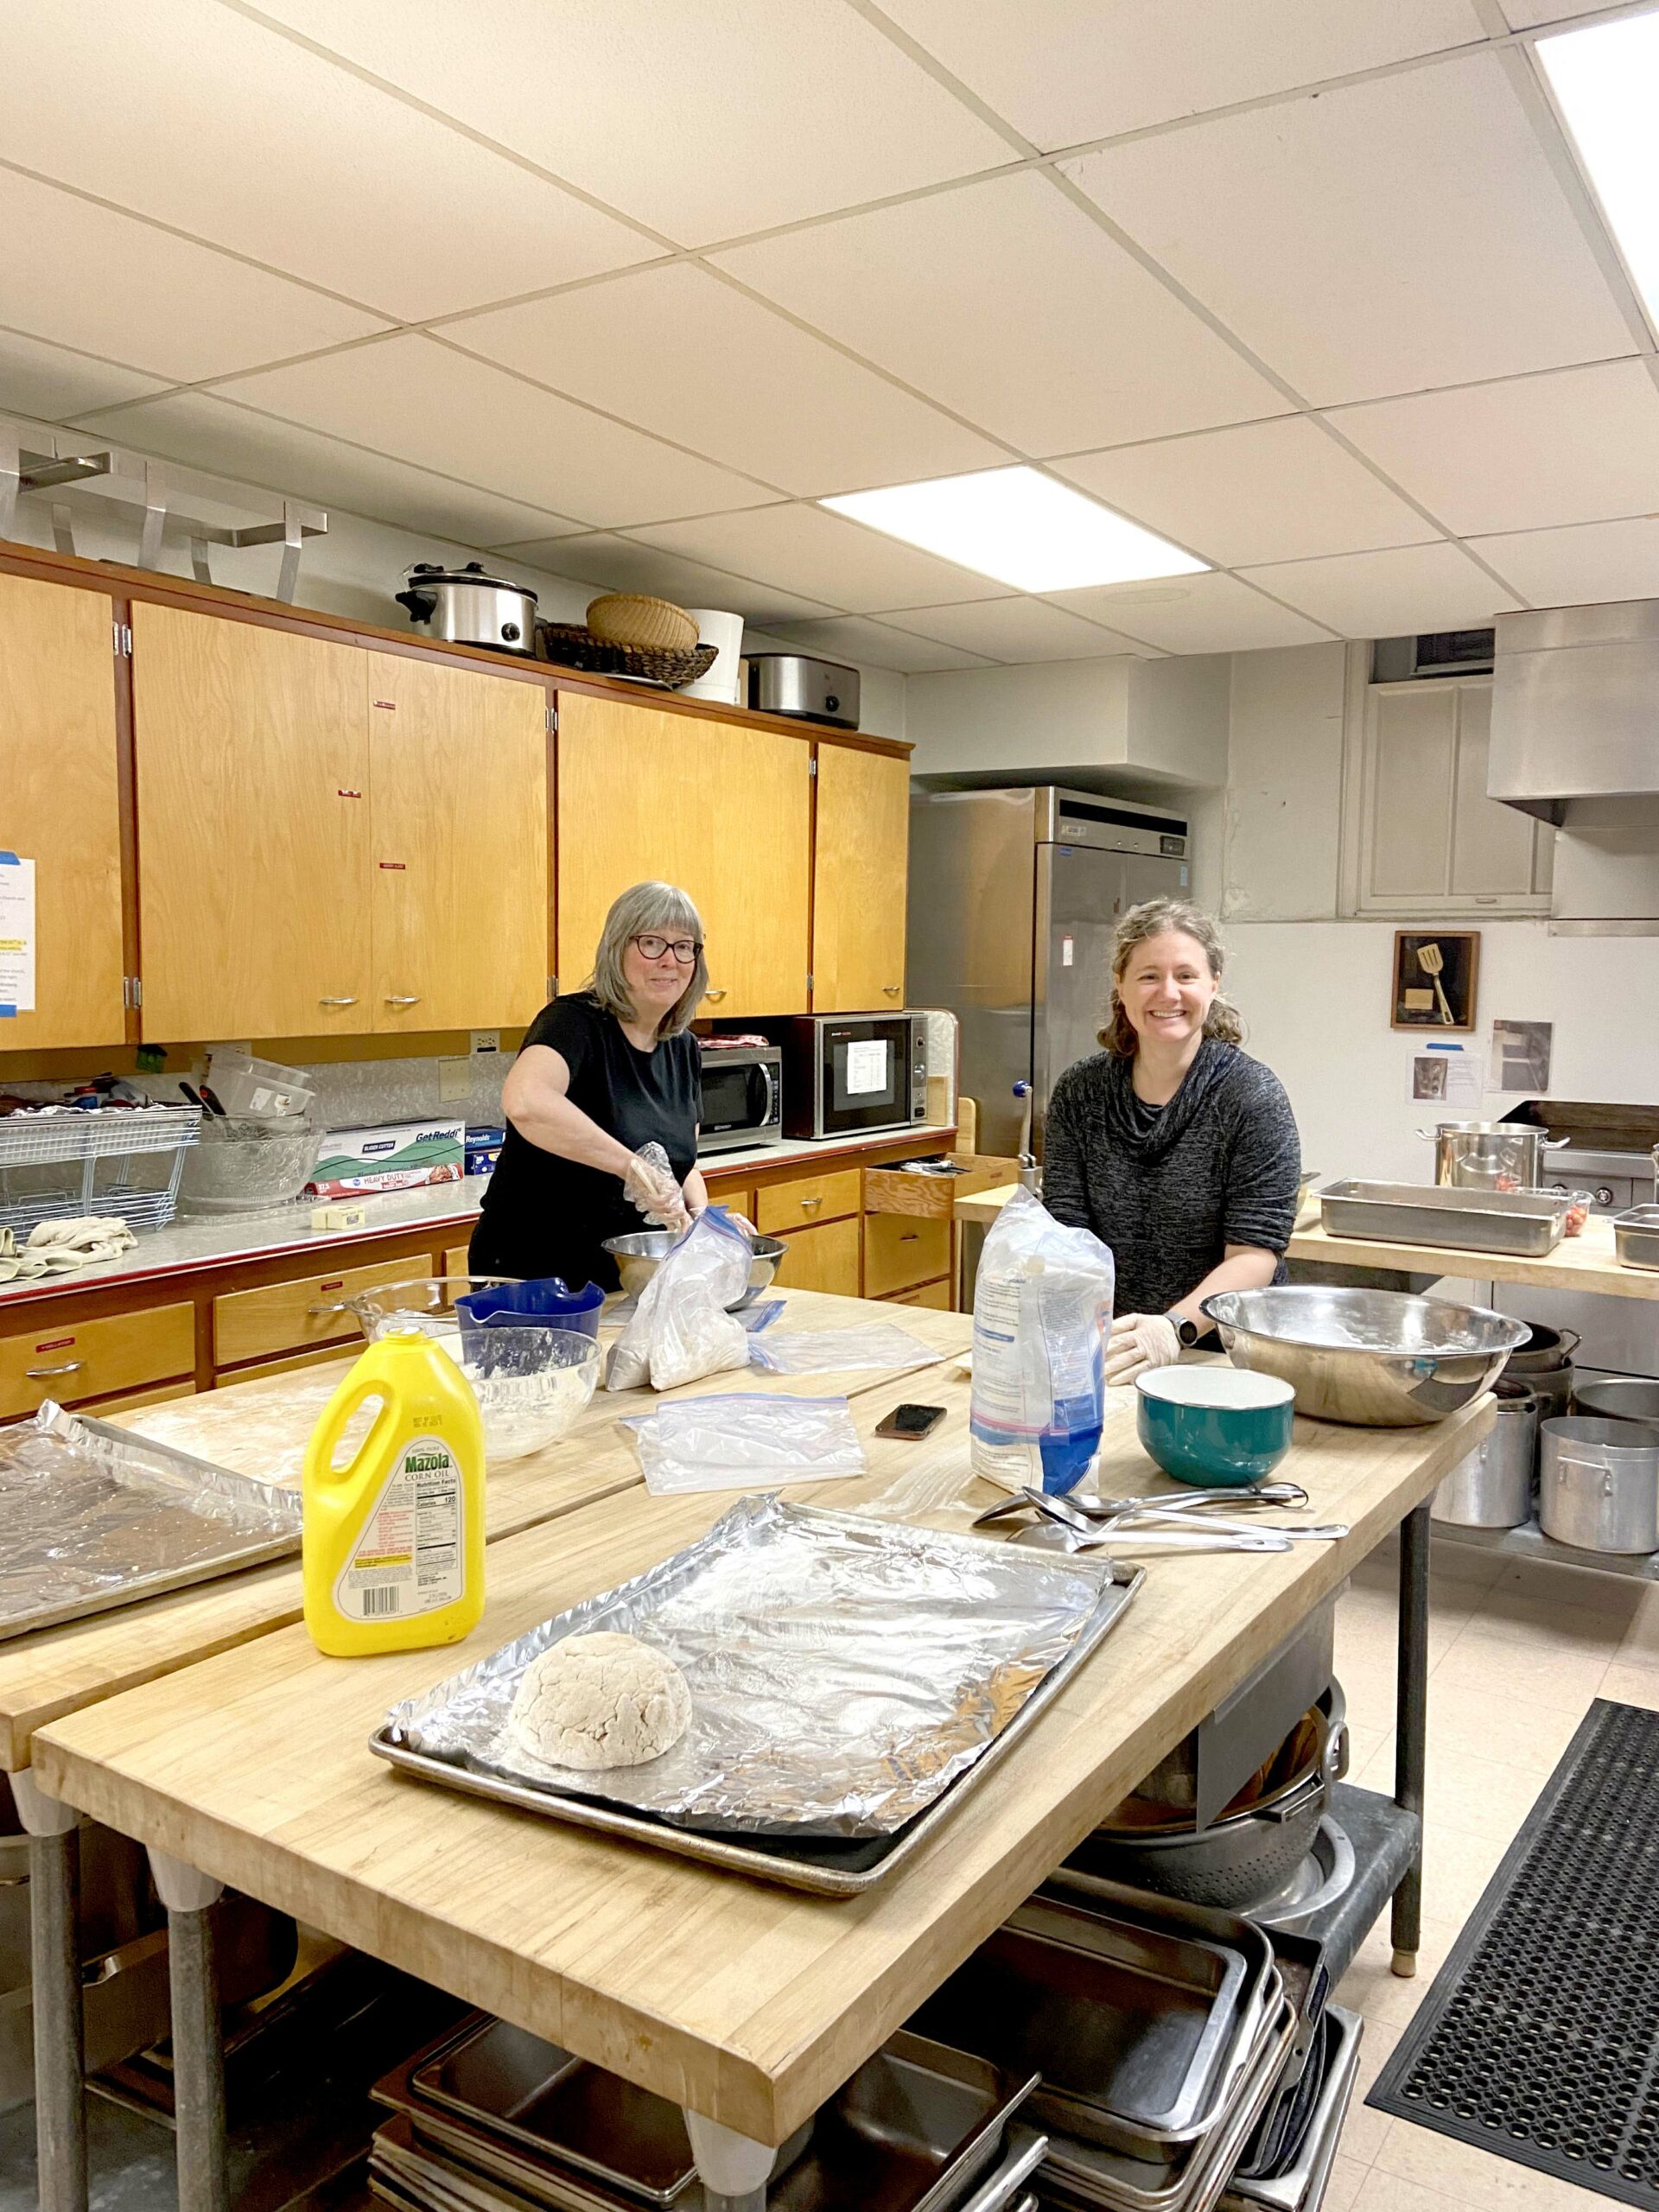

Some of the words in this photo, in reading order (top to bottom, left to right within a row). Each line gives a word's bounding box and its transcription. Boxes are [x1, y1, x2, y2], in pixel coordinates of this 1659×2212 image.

[466, 1134, 491, 1144] Reynolds
[364, 1176, 385, 1185] HEAVY
[386, 1173, 404, 1181] DUTY
[405, 1453, 449, 1473] Mazola
[404, 1472, 431, 1482] CORN
[434, 1470, 449, 1478] OIL
